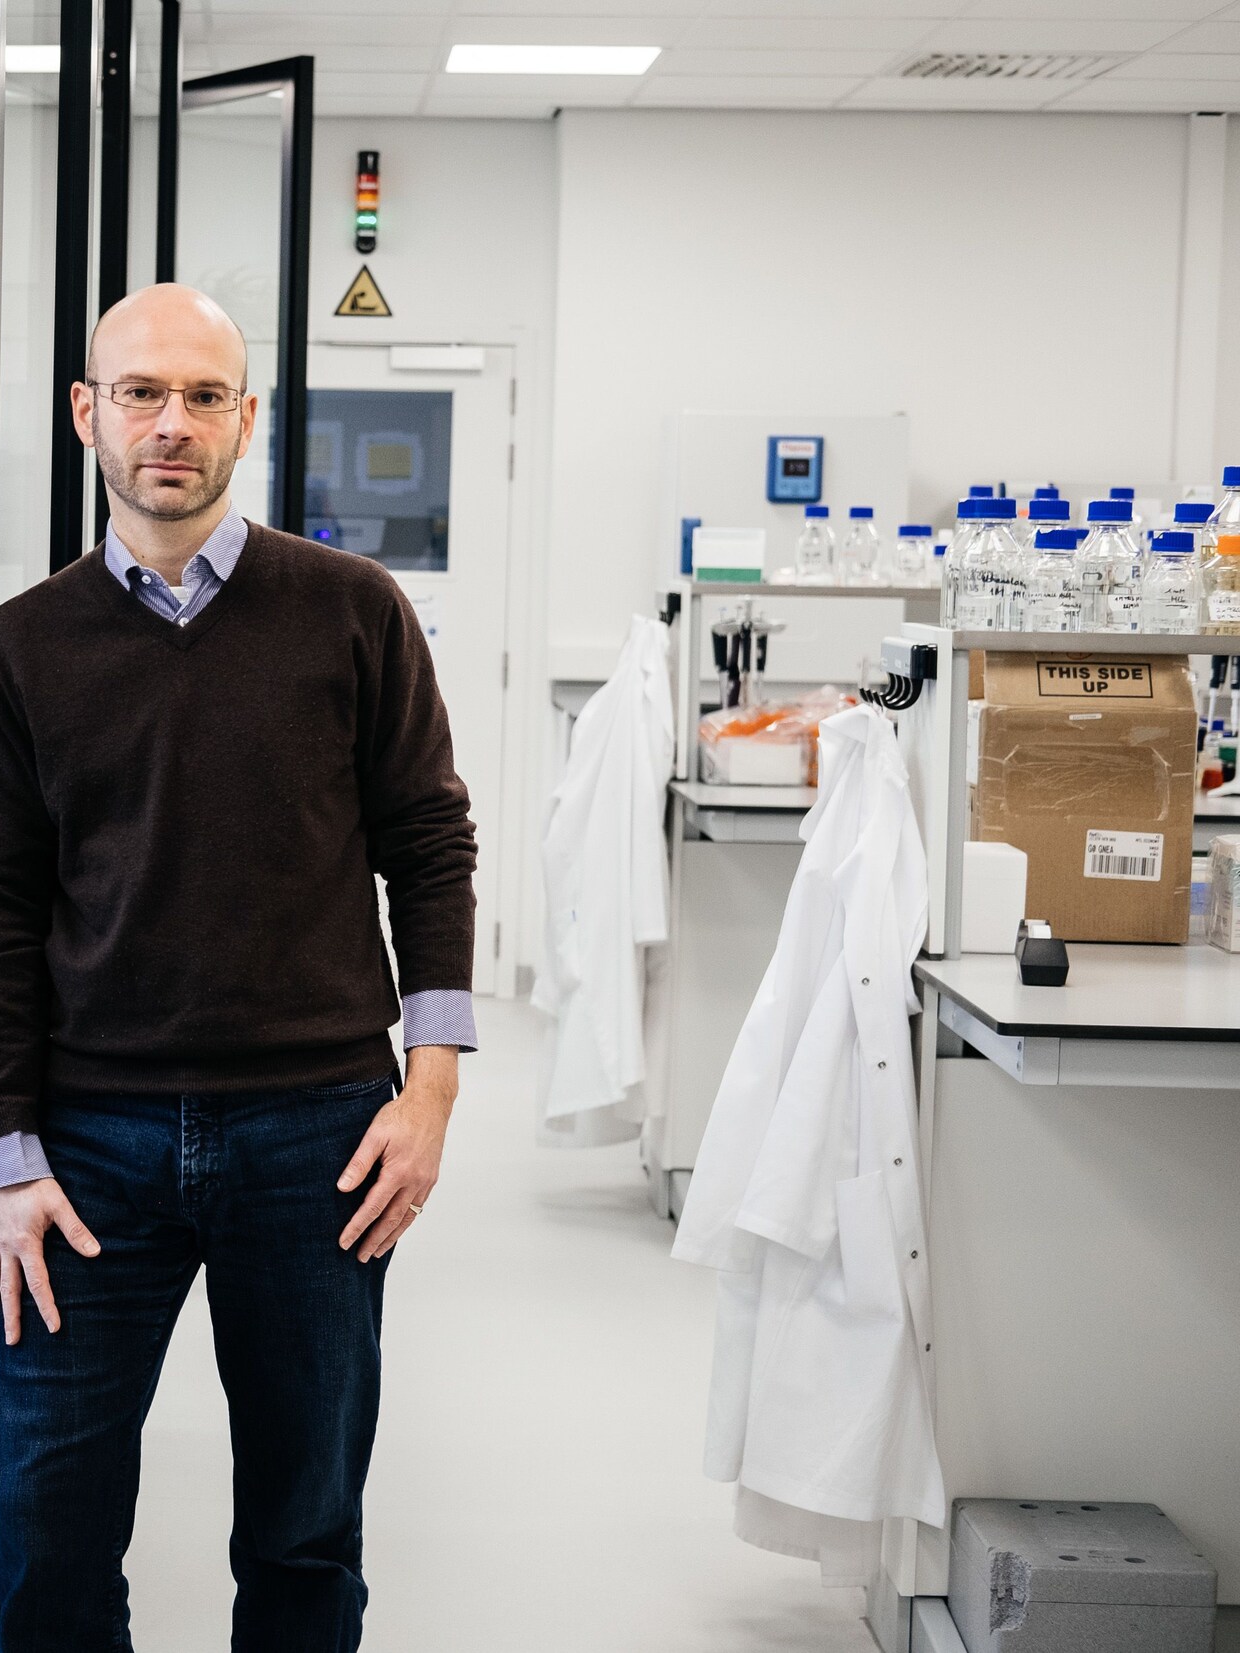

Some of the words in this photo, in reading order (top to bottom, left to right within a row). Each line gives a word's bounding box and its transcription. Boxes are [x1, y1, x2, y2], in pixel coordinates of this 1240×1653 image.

[1045, 666, 1091, 679] THIS
[1097, 667, 1143, 680] SIDE
[1082, 681, 1109, 693] UP
